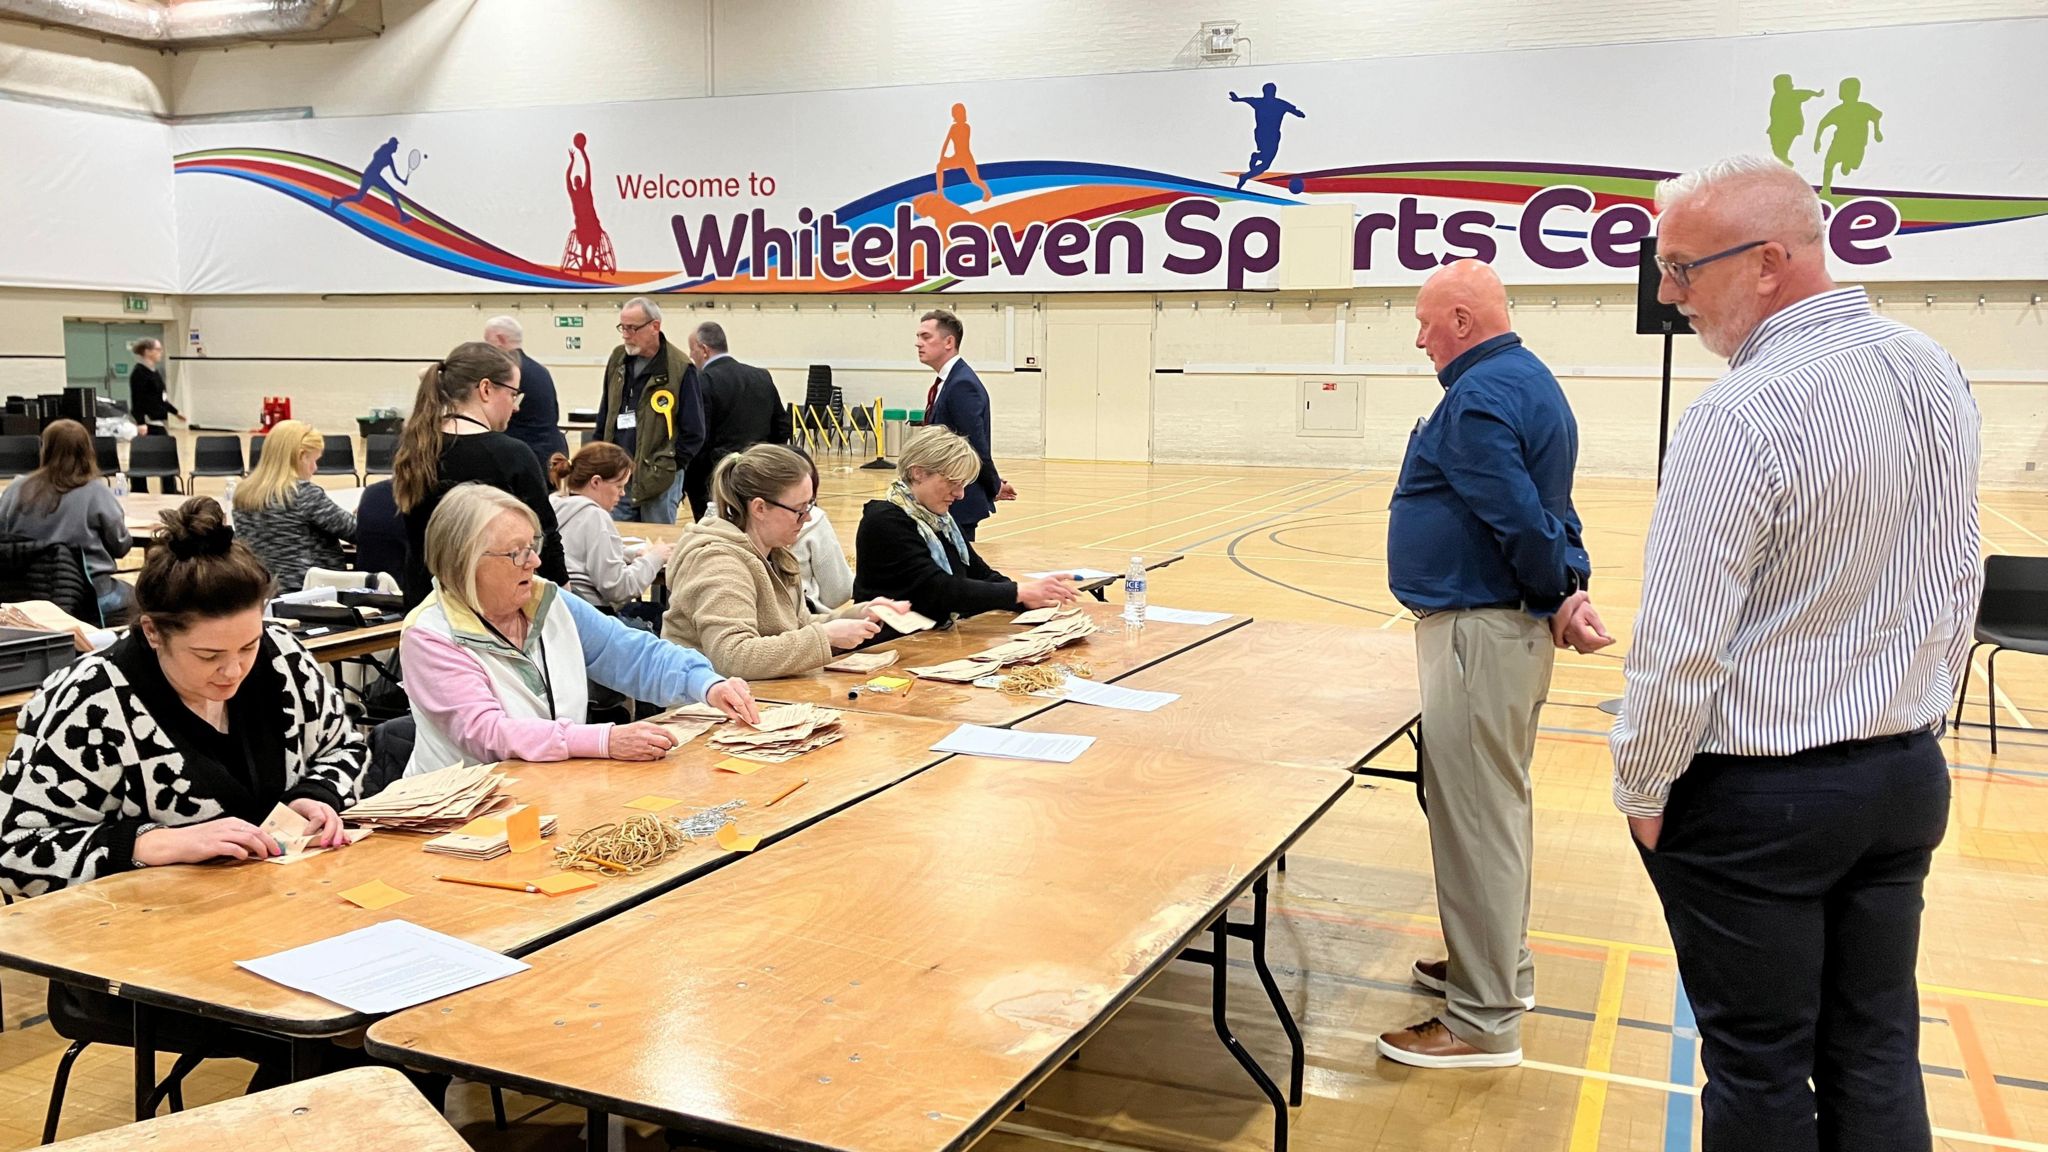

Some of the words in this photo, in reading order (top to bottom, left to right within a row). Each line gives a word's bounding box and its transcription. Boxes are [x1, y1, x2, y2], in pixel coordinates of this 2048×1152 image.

[616, 173, 740, 199] Welcome
[748, 171, 776, 197] to
[671, 204, 1144, 278] Whitehaven
[1161, 197, 1497, 289] Sprts
[1519, 187, 1898, 270] Cee
